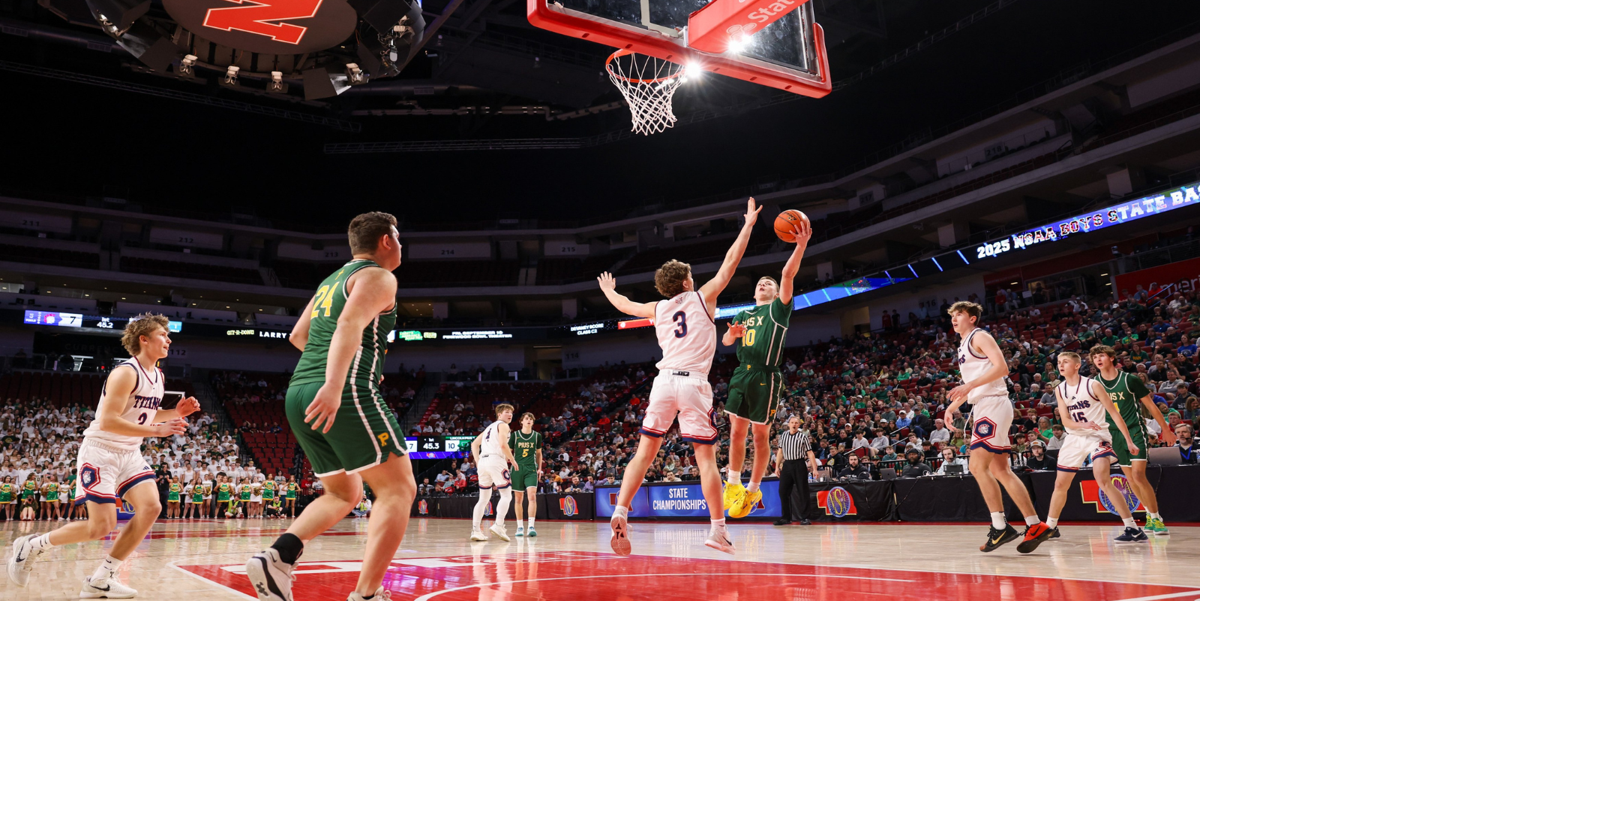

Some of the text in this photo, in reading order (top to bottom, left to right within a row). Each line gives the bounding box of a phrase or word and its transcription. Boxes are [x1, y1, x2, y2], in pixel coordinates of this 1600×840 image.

[977, 238, 1011, 259] 2025
[1013, 226, 1057, 249] NSAA
[1059, 213, 1104, 236] BOYS
[1107, 195, 1168, 223] STATE
[311, 281, 340, 320] 24
[70, 315, 77, 325] 7
[672, 310, 688, 339] 3
[756, 315, 765, 326] X
[259, 330, 288, 339] LARRY
[1117, 391, 1126, 400] X
[377, 432, 390, 447] P
[422, 442, 440, 450] 45.3
[521, 448, 529, 458] 5
[668, 488, 688, 498] STATE
[652, 499, 706, 511] CHAMPIONSHIPS
